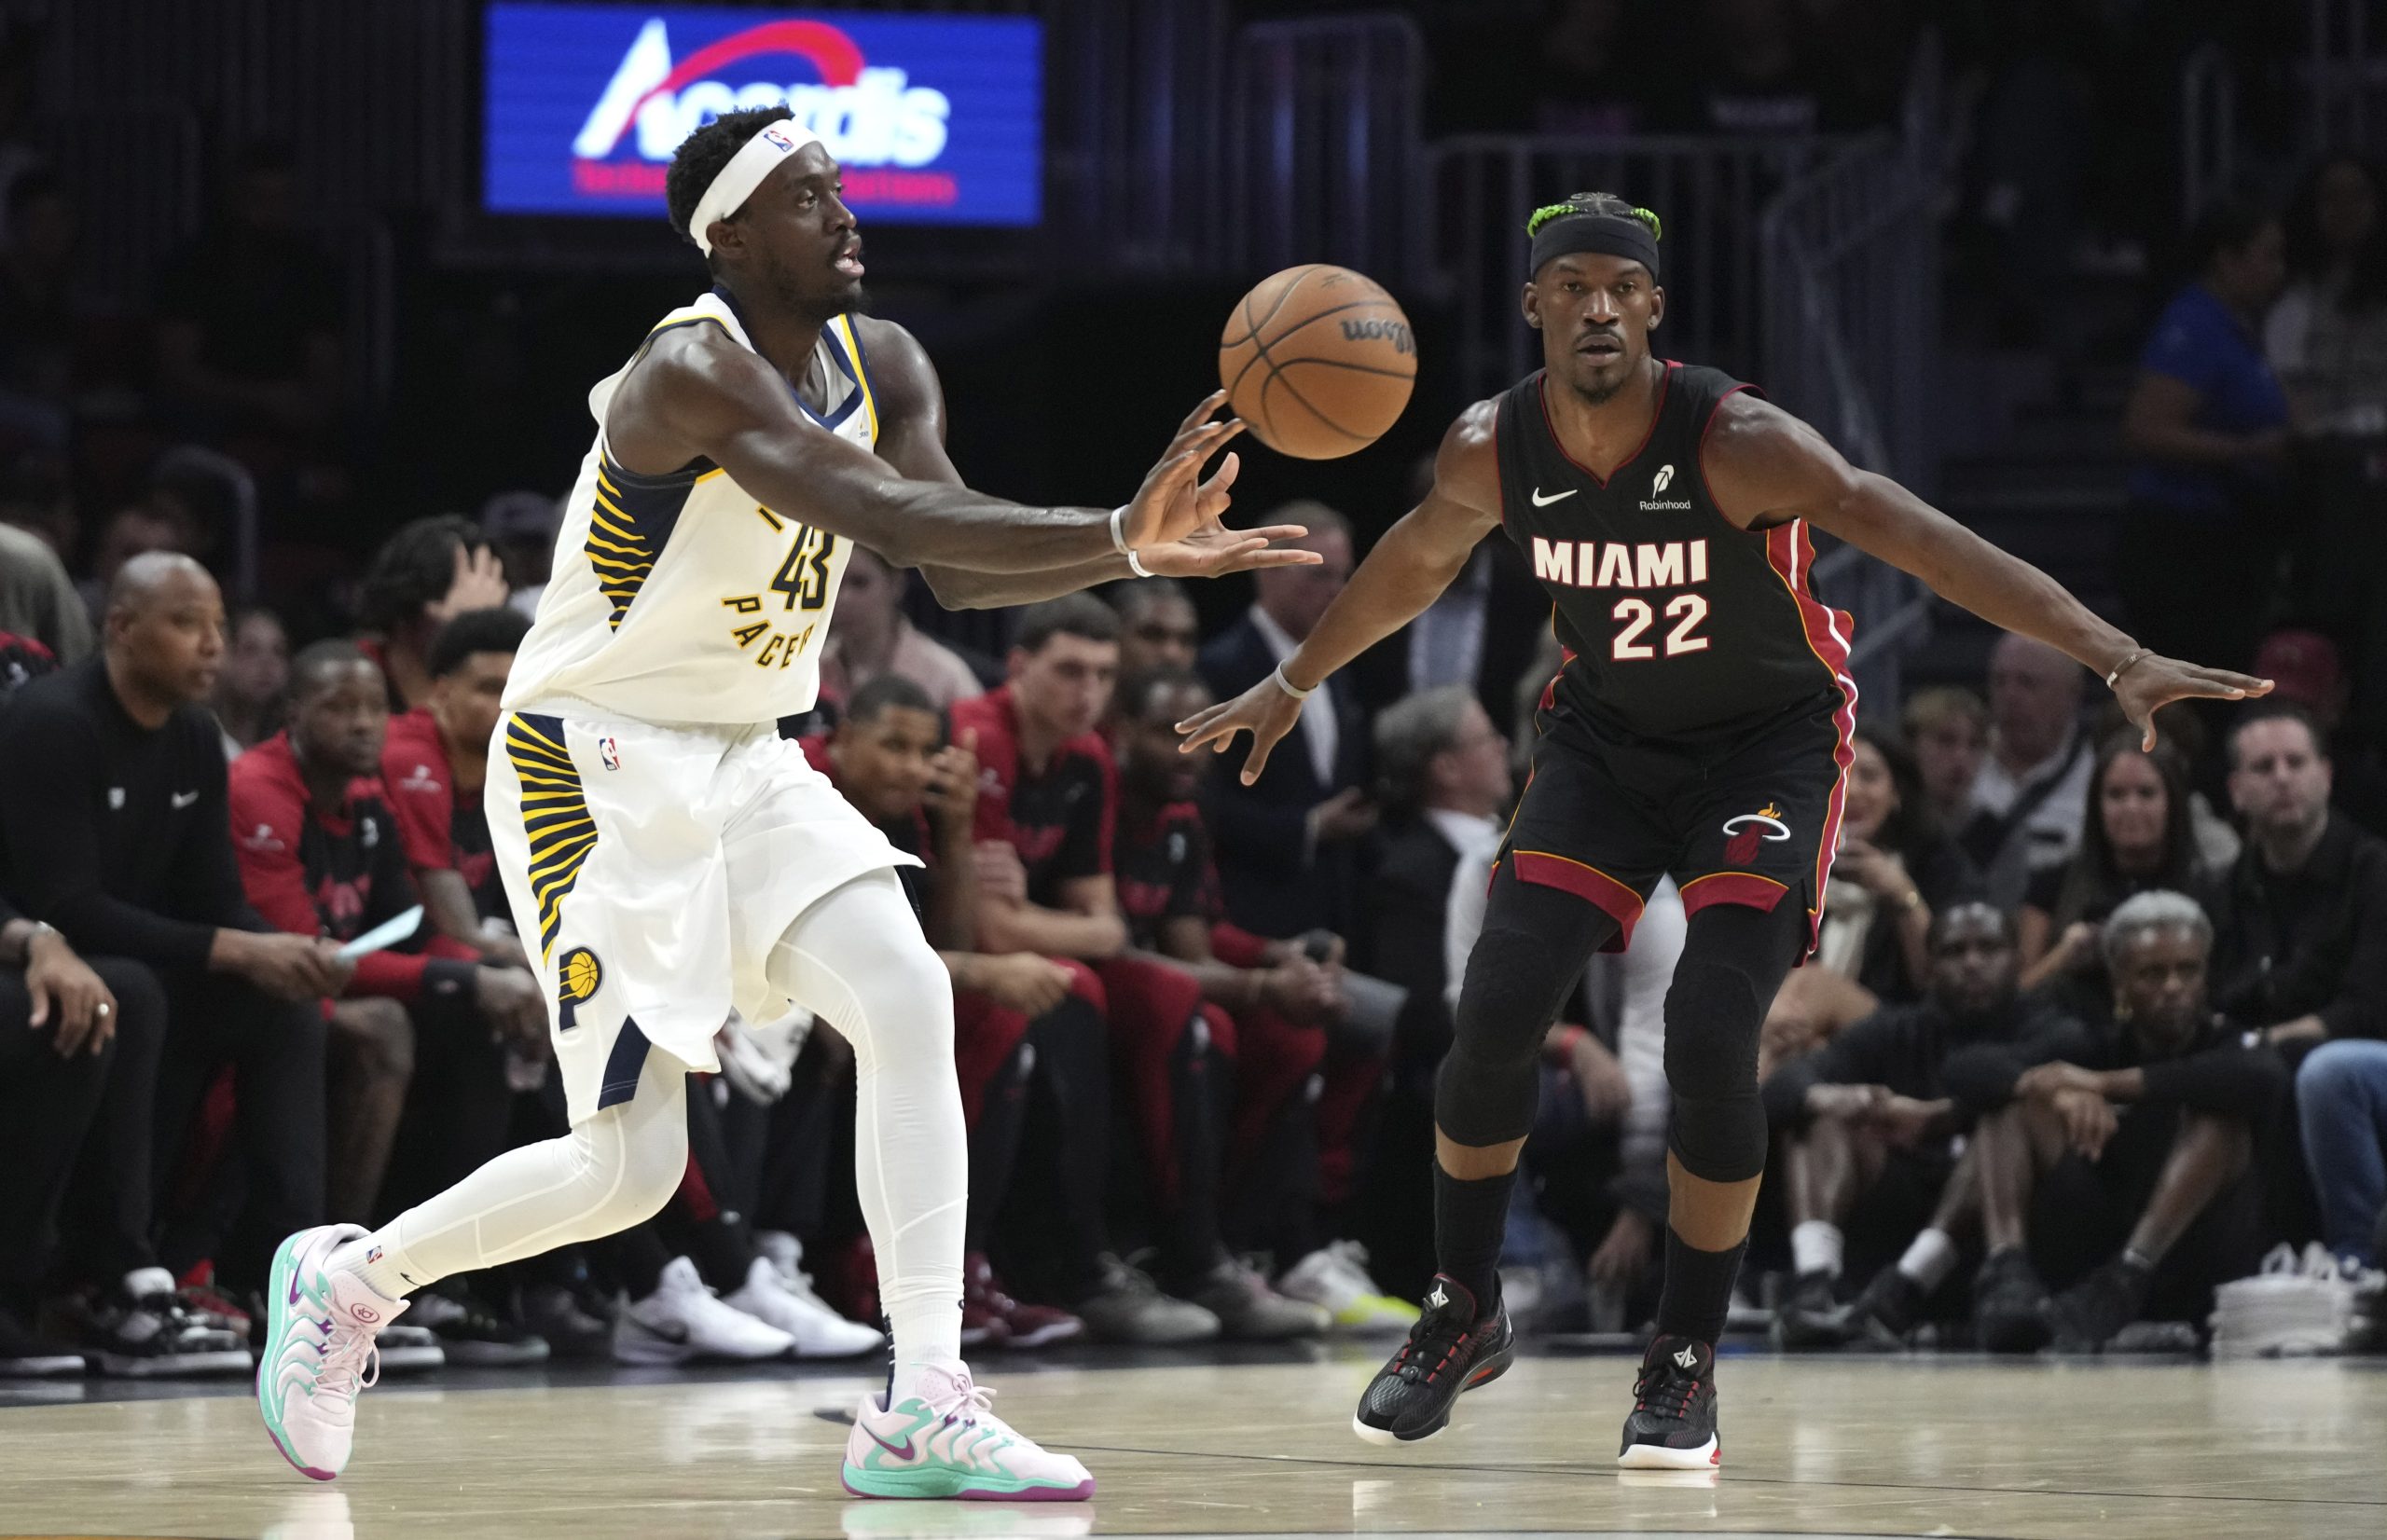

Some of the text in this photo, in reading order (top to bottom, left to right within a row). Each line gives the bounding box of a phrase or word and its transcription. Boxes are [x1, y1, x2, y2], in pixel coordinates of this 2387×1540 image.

[1639, 499, 1691, 511] Robinhood
[768, 523, 835, 612] 43
[1532, 535, 1709, 589] MIAMI
[1610, 591, 1712, 661] 22
